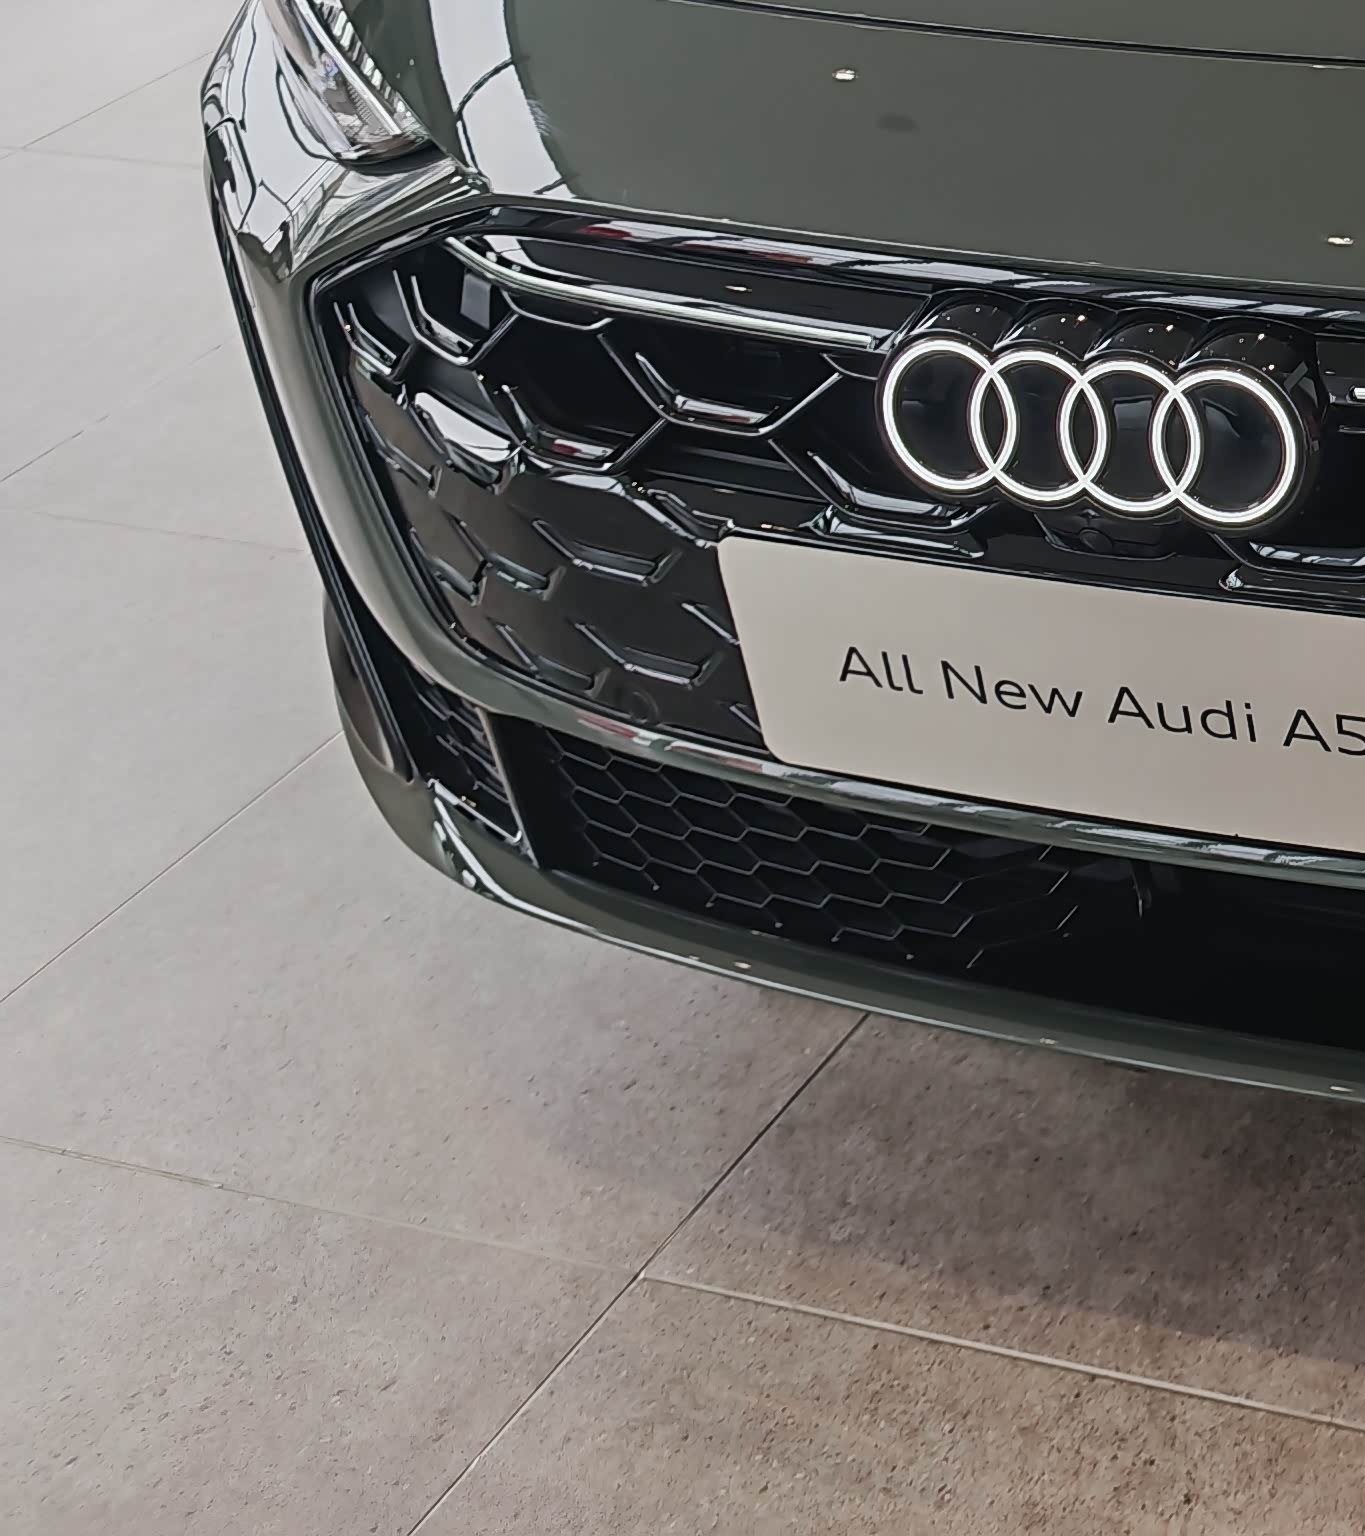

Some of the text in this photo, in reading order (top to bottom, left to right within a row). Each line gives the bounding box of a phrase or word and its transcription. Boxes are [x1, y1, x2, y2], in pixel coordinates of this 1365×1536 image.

[838, 646, 924, 696] All
[939, 659, 1084, 718] New
[1107, 686, 1258, 743] Audi
